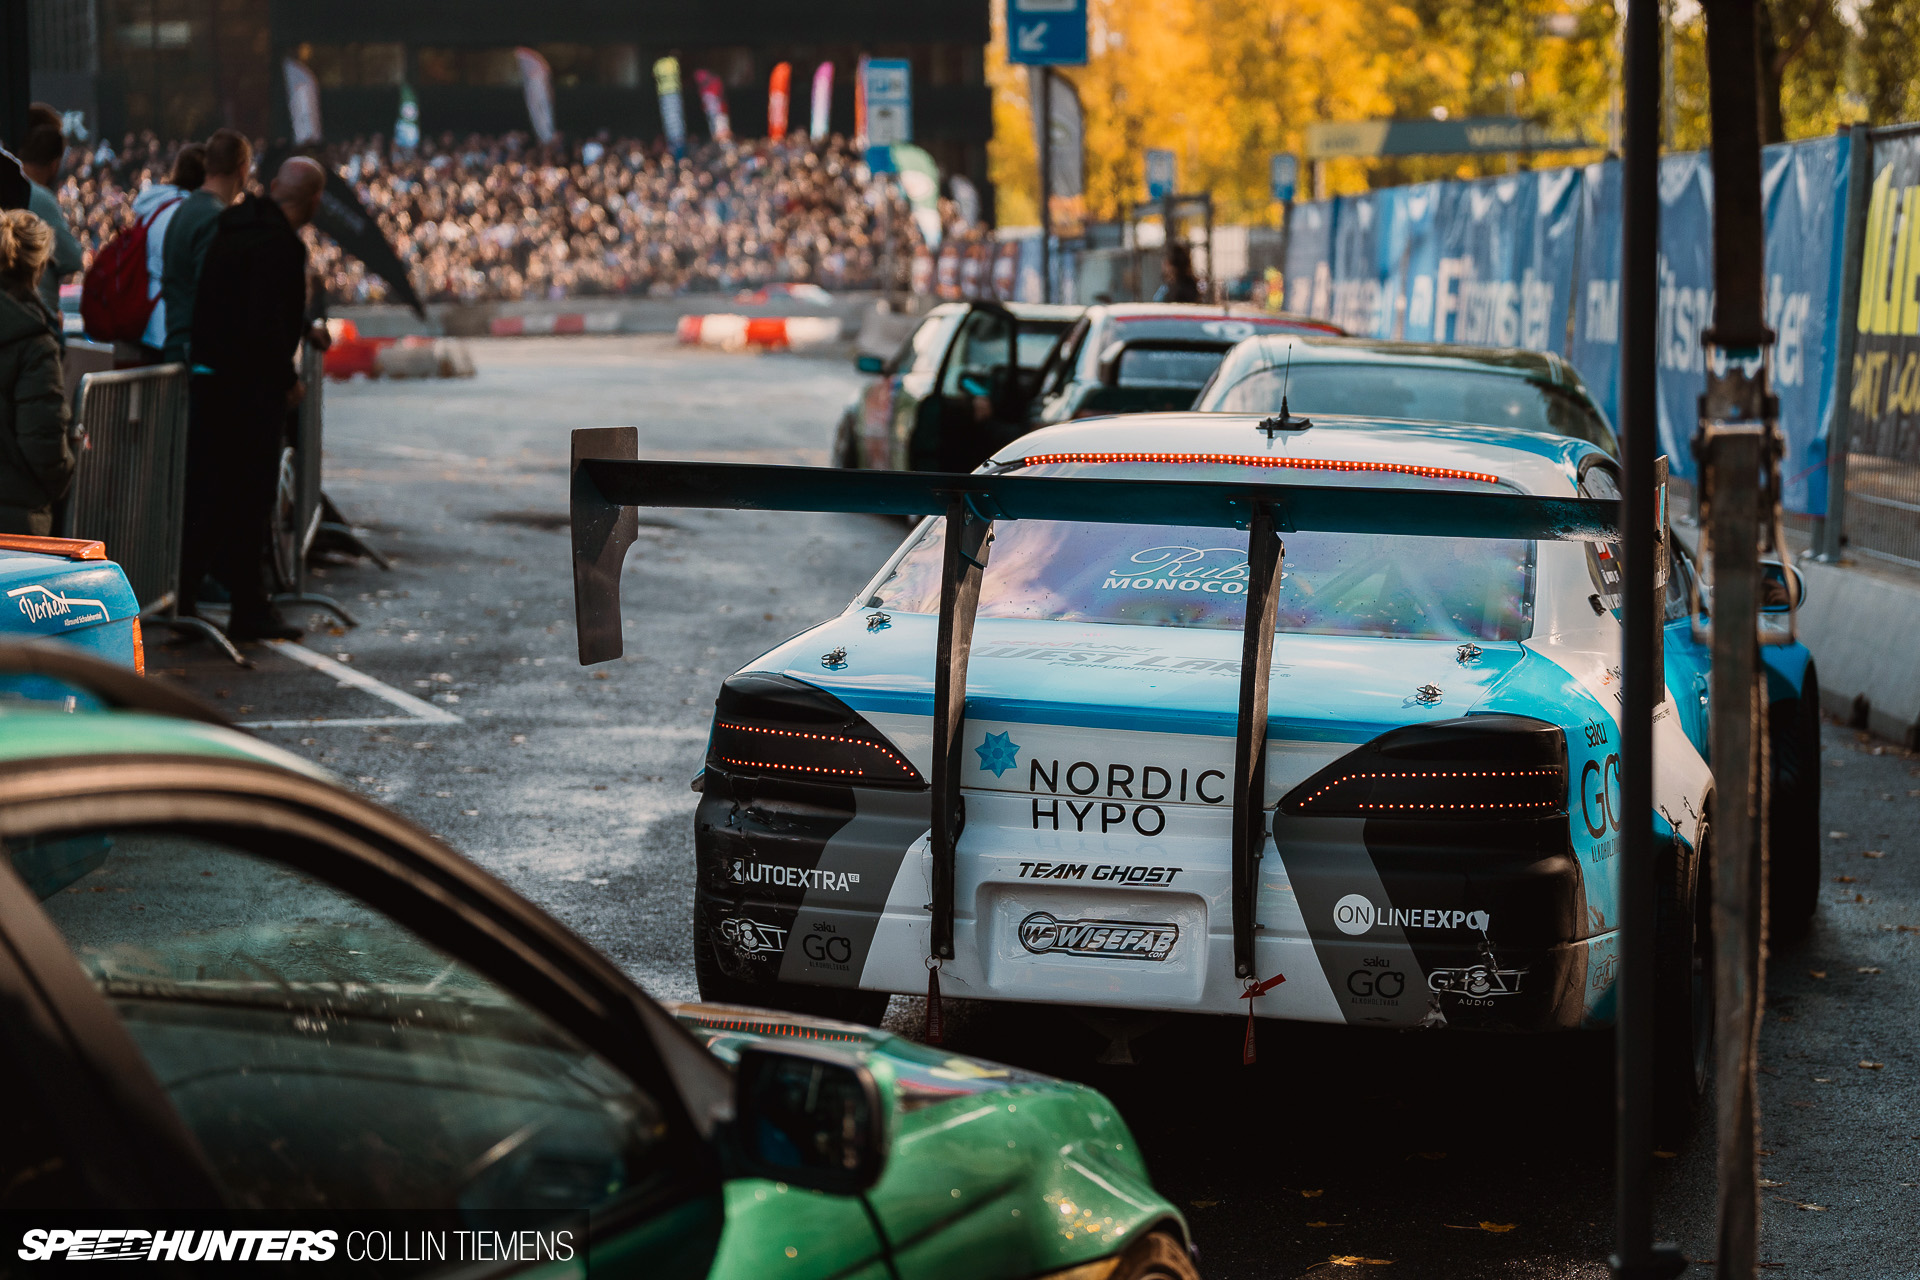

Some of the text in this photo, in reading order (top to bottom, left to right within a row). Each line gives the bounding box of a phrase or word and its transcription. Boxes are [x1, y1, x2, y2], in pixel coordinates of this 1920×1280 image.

[1102, 577, 1285, 595] MONOCO
[1585, 717, 1609, 749] saku
[1029, 758, 1226, 804] NORDIC
[1032, 798, 1166, 837] HYPO
[1018, 861, 1184, 885] TEAM GHOST
[812, 921, 836, 934] saku
[1057, 926, 1176, 953] WISEFAB
[802, 933, 852, 964] GO
[1362, 956, 1390, 969] saku
[1346, 969, 1405, 999] GO
[1458, 998, 1495, 1008] AUDIO
